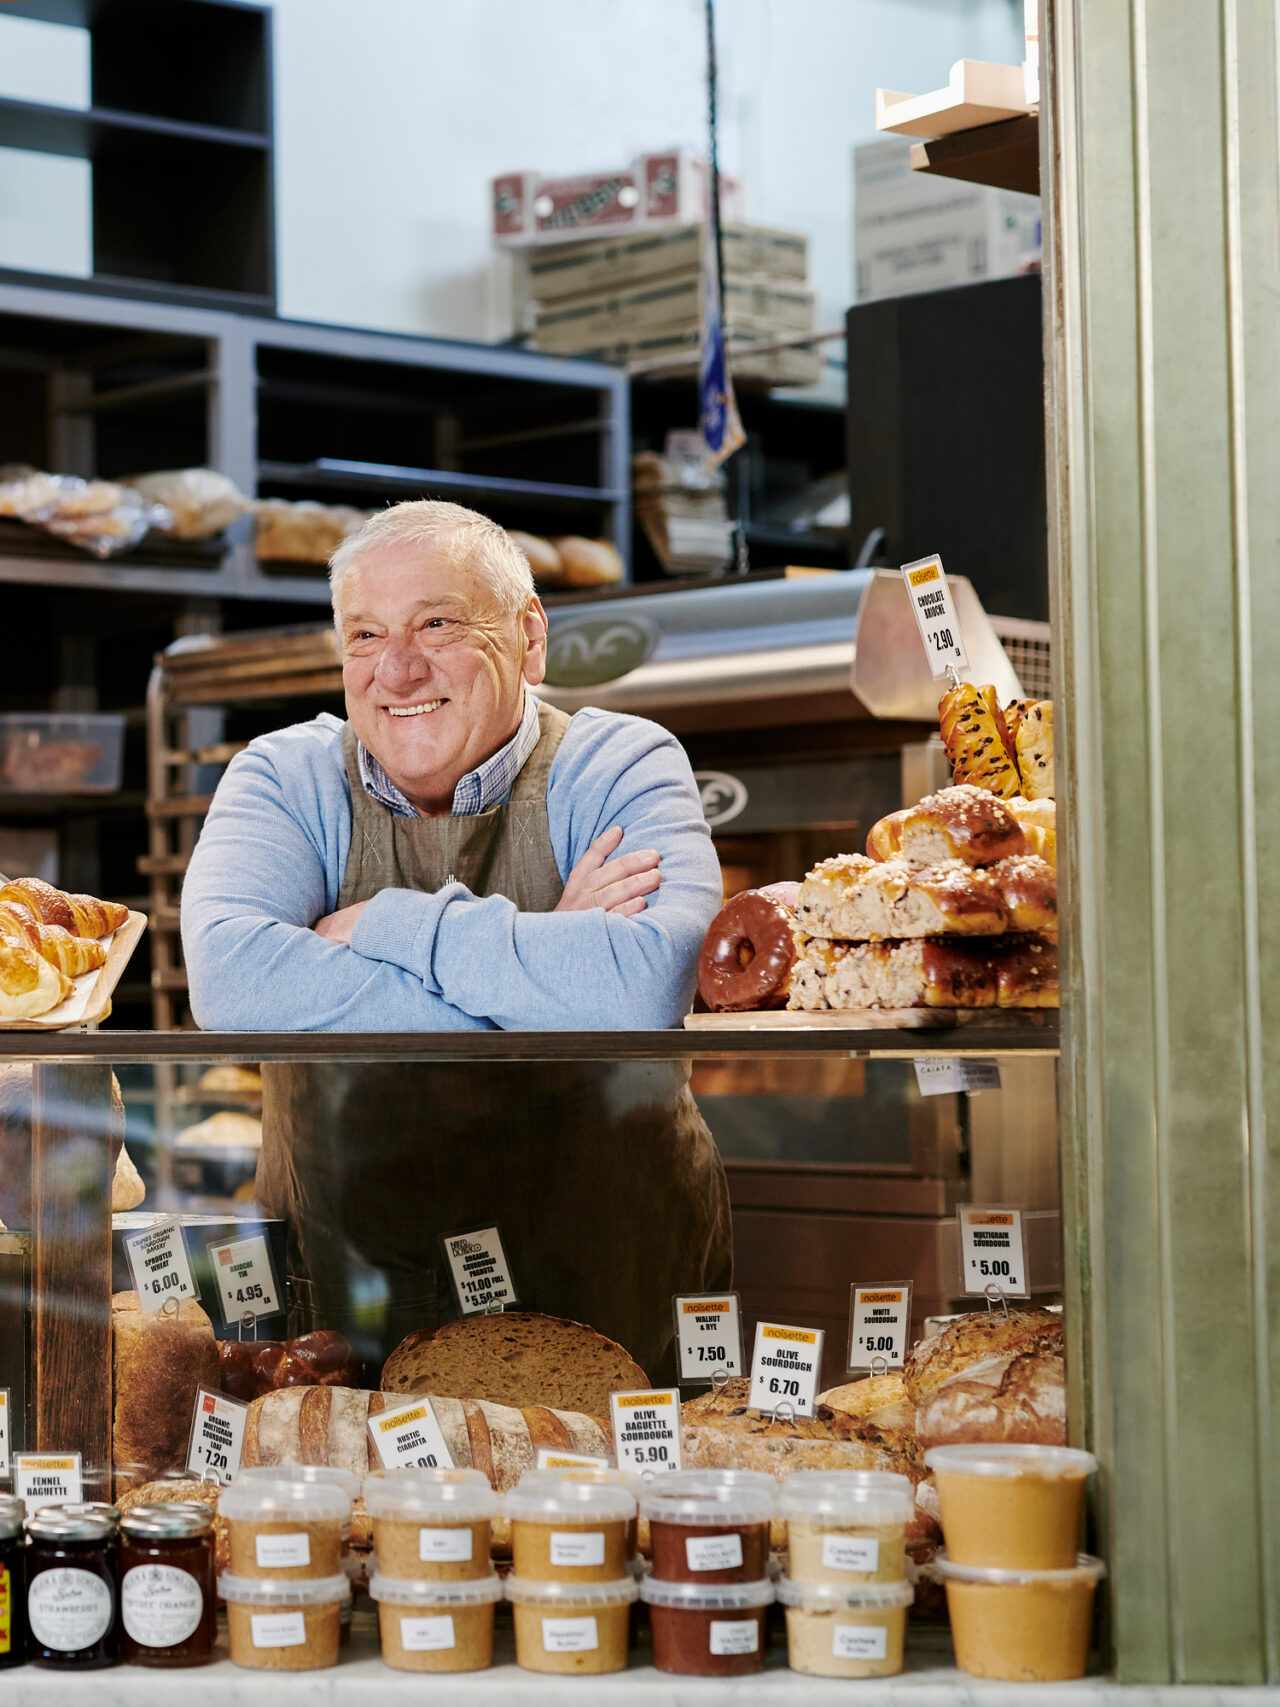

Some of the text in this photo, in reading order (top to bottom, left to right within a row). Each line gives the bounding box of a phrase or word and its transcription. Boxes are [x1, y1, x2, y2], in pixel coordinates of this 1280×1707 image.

[917, 590, 944, 607] CHOCOLATE
[924, 603, 946, 619] BRIOCHE
[933, 628, 954, 651] 2.90
[973, 1231, 1009, 1239] MULTIGRAIN
[973, 1239, 1010, 1248] SOURDOUGH
[144, 1250, 173, 1267] SPROUTED
[463, 1257, 496, 1271] SOURDOUGH
[465, 1251, 489, 1263] ORGANIC
[151, 1259, 169, 1272] WHEAT
[980, 1260, 1010, 1276] 5.00
[1009, 1277, 1017, 1285] EA
[152, 1272, 180, 1294] 6.00
[466, 1277, 492, 1293] 11.00
[237, 1284, 263, 1303] 4.95
[471, 1291, 494, 1307] 5.50
[695, 1315, 721, 1323] WALNUT
[872, 1308, 890, 1316] WHITE
[706, 1323, 717, 1331] RYE
[864, 1316, 898, 1324] SOURDOUGH
[866, 1336, 894, 1351] 5.00
[697, 1346, 726, 1361] 7.50
[726, 1361, 735, 1369] EA
[776, 1349, 800, 1361] OLIVE
[760, 1356, 812, 1372] SOURDOUGH
[769, 1378, 800, 1396] 6.70
[208, 1415, 230, 1429] ORGANIC
[633, 1410, 657, 1420] OLIVE
[203, 1421, 233, 1438] MULTIGRAIN
[625, 1420, 667, 1431] BAGUETTE
[202, 1429, 233, 1447] SOURDOUGH
[397, 1430, 421, 1444] RUSTIC
[620, 1430, 673, 1442] SOURDOUGH
[210, 1441, 222, 1451] LOAF
[397, 1437, 427, 1453] CIABATTA
[205, 1449, 228, 1469] 7.20
[634, 1446, 668, 1463] 5.90
[668, 1462, 677, 1470] EA
[32, 1476, 61, 1486] FENNEL
[27, 1486, 68, 1496] BAGUETTE
